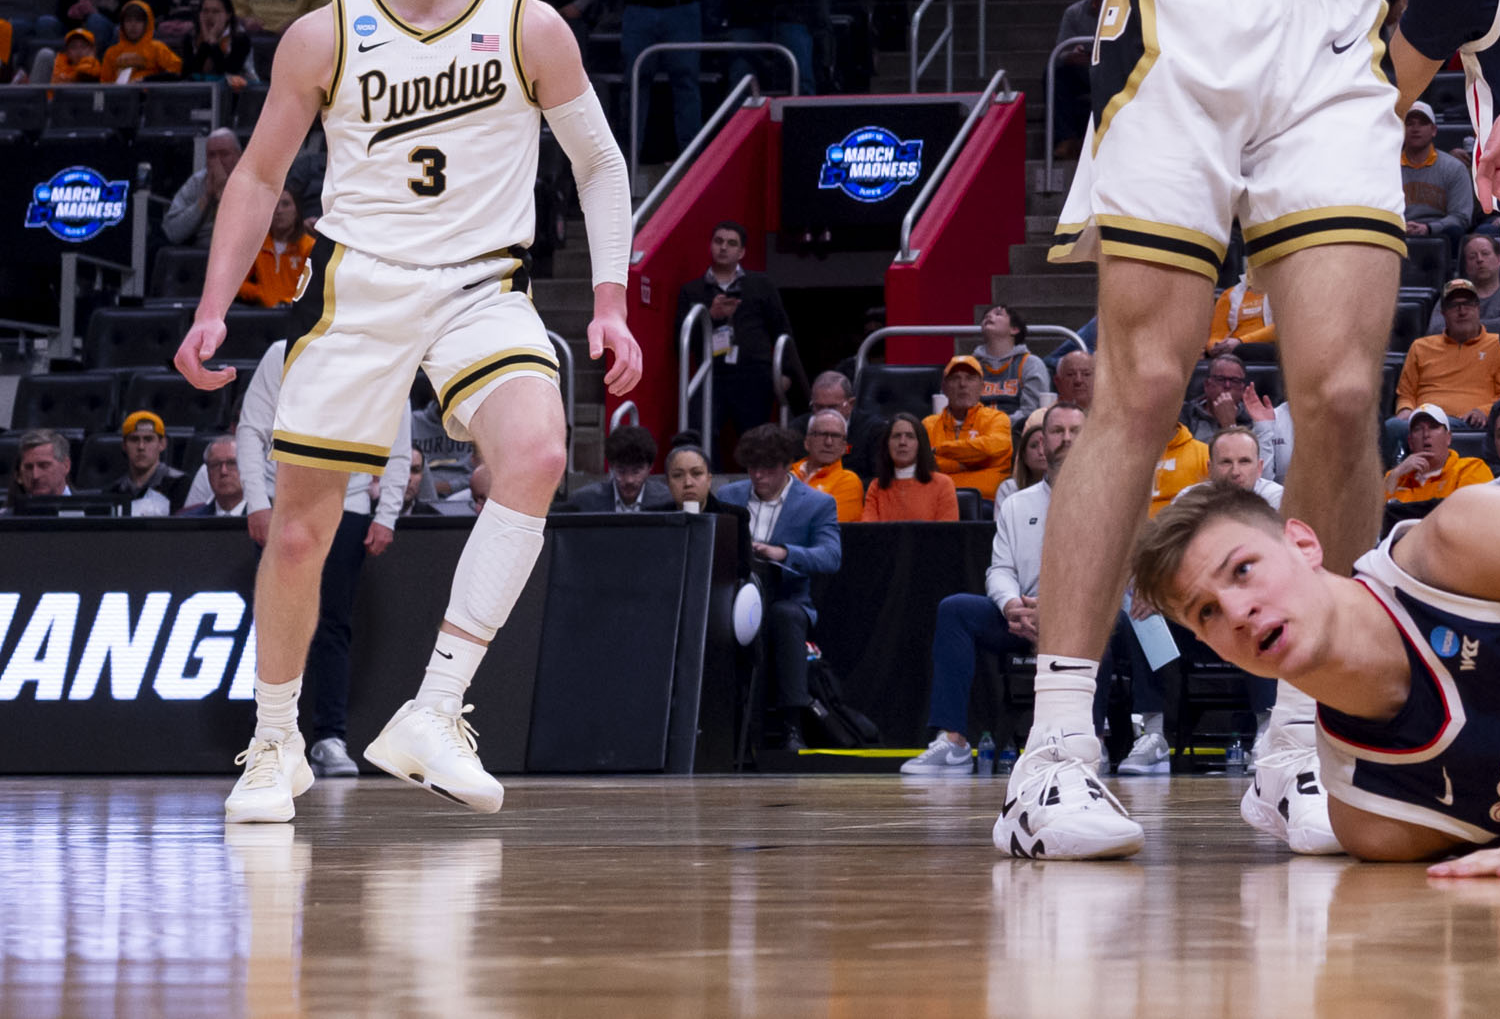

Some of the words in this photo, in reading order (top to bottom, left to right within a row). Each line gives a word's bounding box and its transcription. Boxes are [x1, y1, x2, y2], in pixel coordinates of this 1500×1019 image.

[357, 56, 507, 142] Purdue
[844, 146, 895, 162] MARCH
[408, 146, 447, 197] 3
[849, 162, 918, 179] MADNESS
[51, 186, 101, 202] MARCH
[55, 202, 123, 218] MADNESS
[980, 379, 1019, 397] OLS
